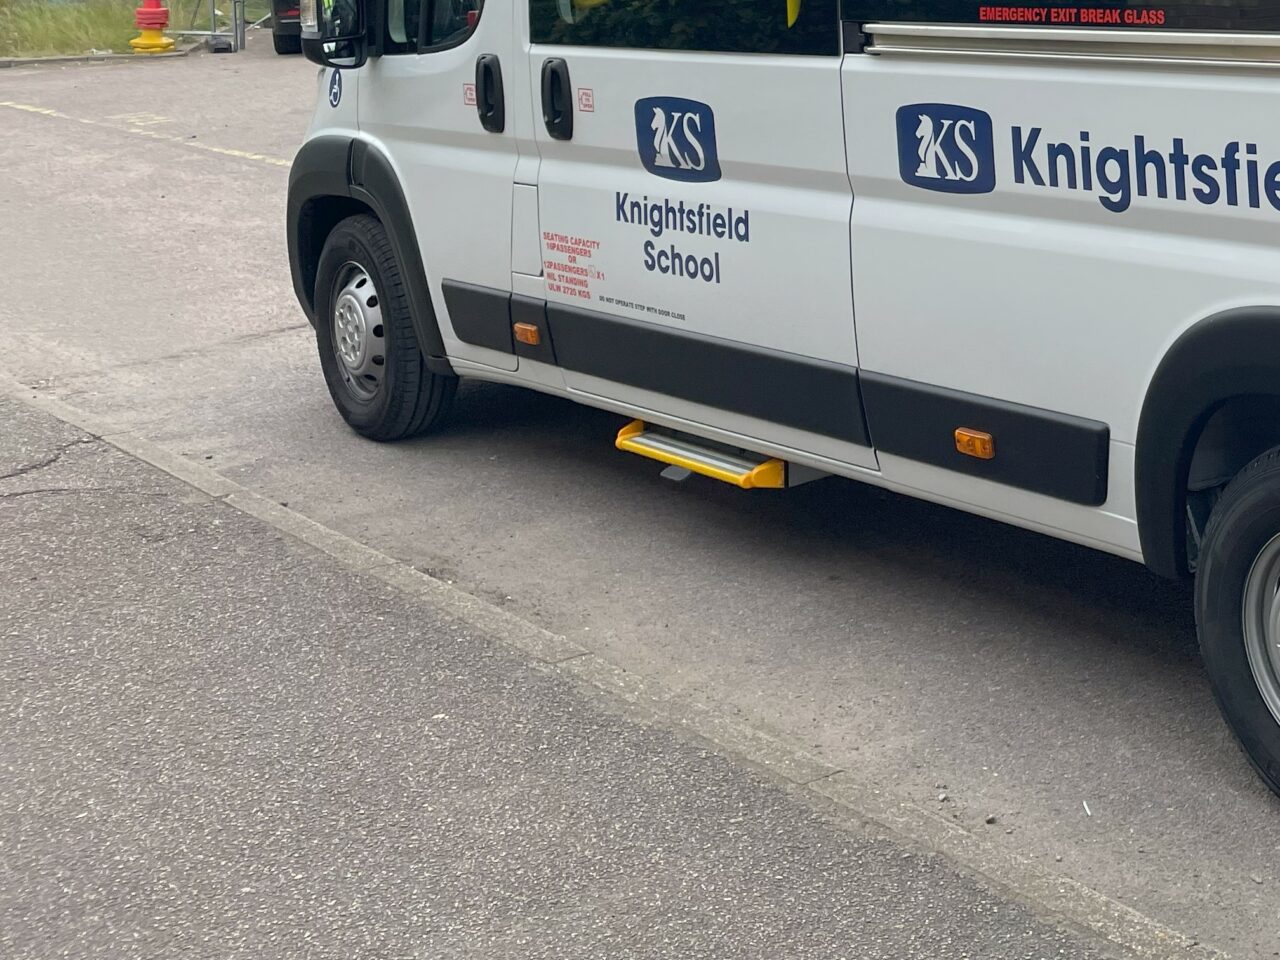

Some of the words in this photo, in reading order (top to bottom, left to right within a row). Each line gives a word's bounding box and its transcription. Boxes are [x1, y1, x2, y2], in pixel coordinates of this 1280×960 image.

[979, 6, 1047, 22] EMERGENCY
[1050, 8, 1077, 23] EXIT
[1080, 9, 1121, 24] BREAK
[1124, 10, 1165, 25] GLASS
[654, 111, 705, 171] KS
[917, 119, 979, 182] KS
[616, 192, 750, 242] Knightsfield
[543, 231, 568, 244] SEATING
[570, 237, 600, 249] CAPACITY
[568, 254, 577, 264] OR
[644, 240, 721, 283] School
[558, 274, 588, 288] STANDING
